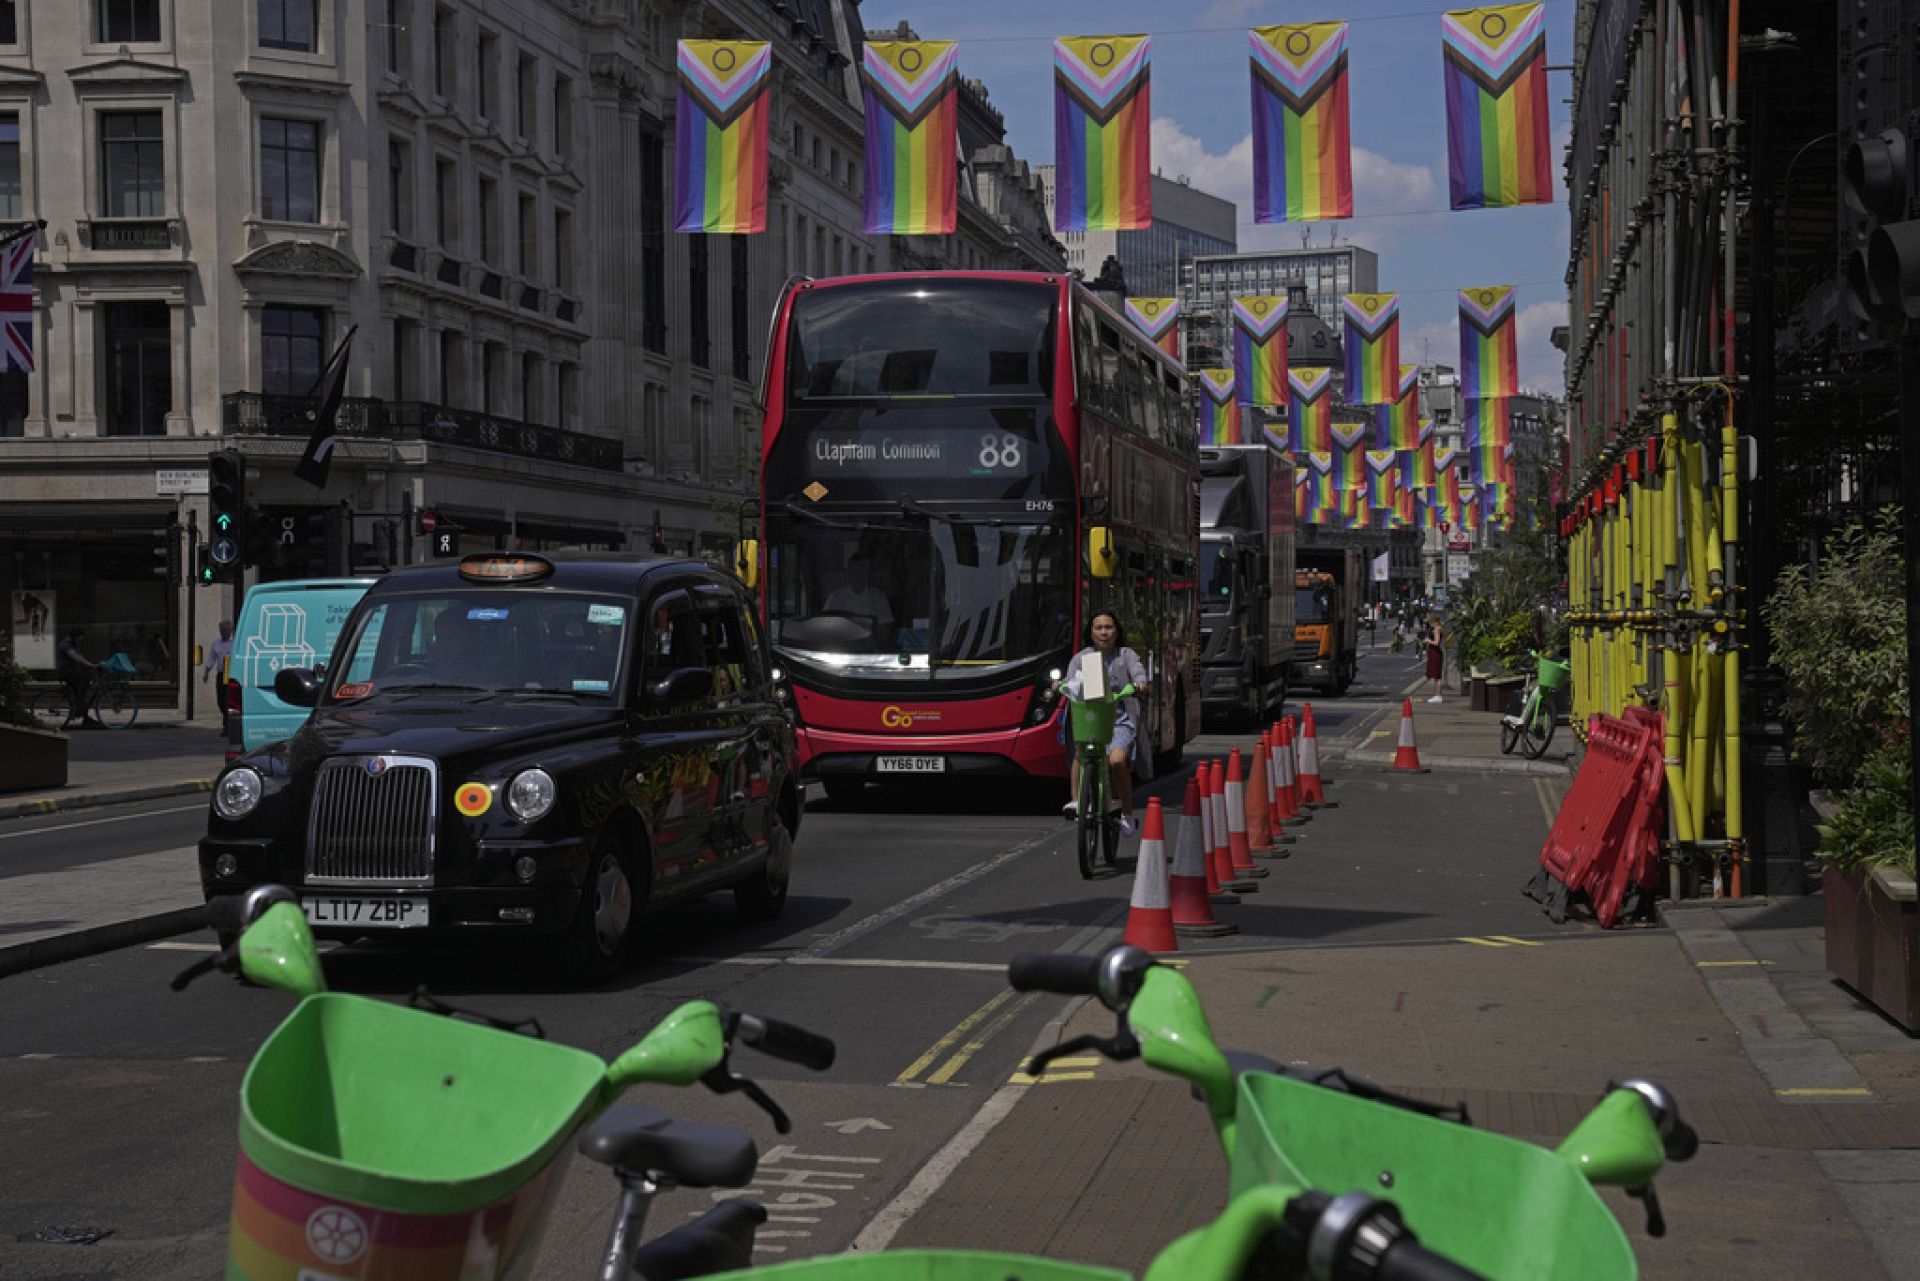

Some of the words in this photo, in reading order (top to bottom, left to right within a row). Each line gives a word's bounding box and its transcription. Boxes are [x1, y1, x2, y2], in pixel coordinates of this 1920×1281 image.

[815, 438, 877, 465] Clapham
[881, 438, 941, 460] Common
[978, 432, 1021, 468] 88
[881, 706, 912, 728] Go
[314, 899, 363, 921] LT17
[369, 899, 413, 922] ZBP
